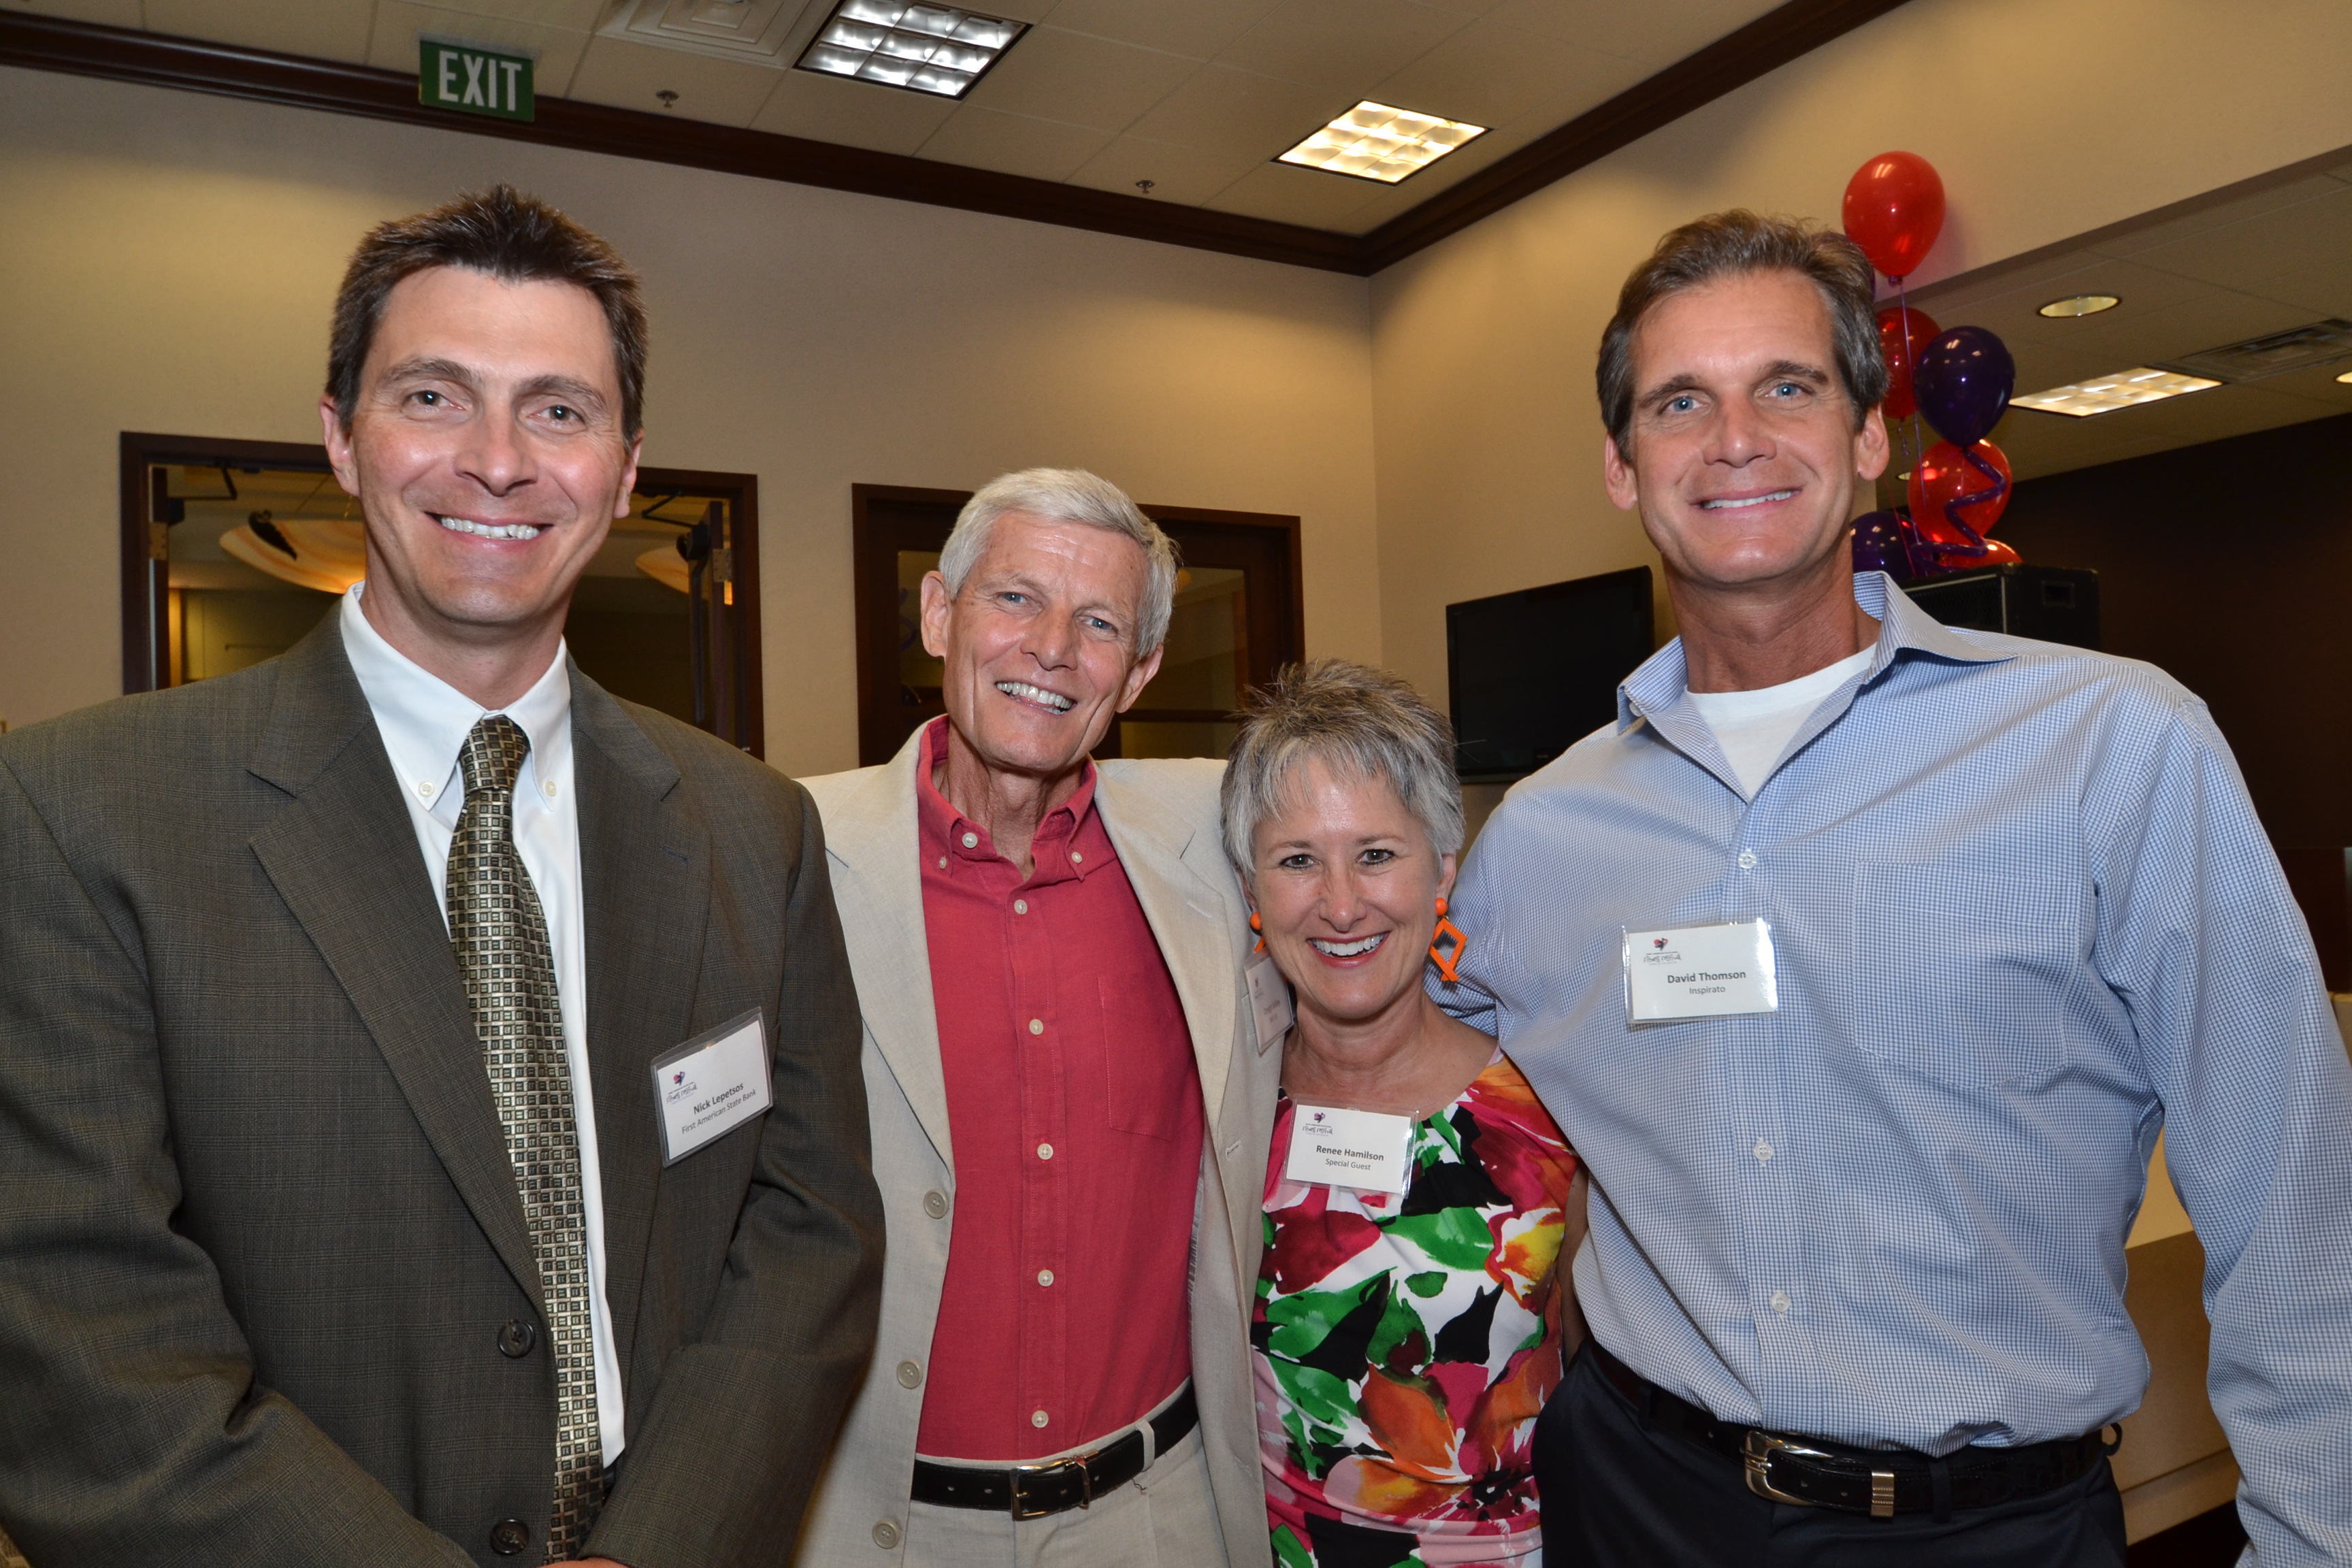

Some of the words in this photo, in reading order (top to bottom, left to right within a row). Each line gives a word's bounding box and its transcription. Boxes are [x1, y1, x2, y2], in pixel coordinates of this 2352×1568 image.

[439, 50, 522, 112] EXIT
[1667, 973, 1697, 983] David
[1699, 971, 1746, 982] Thomson
[1689, 985, 1726, 996] Inspirato
[693, 1100, 711, 1115] Nick
[712, 1083, 744, 1105] Lepetsos
[681, 1120, 697, 1134] First
[697, 1107, 726, 1127] American
[726, 1098, 742, 1113] State
[742, 1089, 757, 1102] Bank
[1316, 1145, 1342, 1156] Renee
[1343, 1148, 1384, 1161] Hamilson
[1325, 1158, 1350, 1168] Special
[1350, 1162, 1371, 1171] Guest
